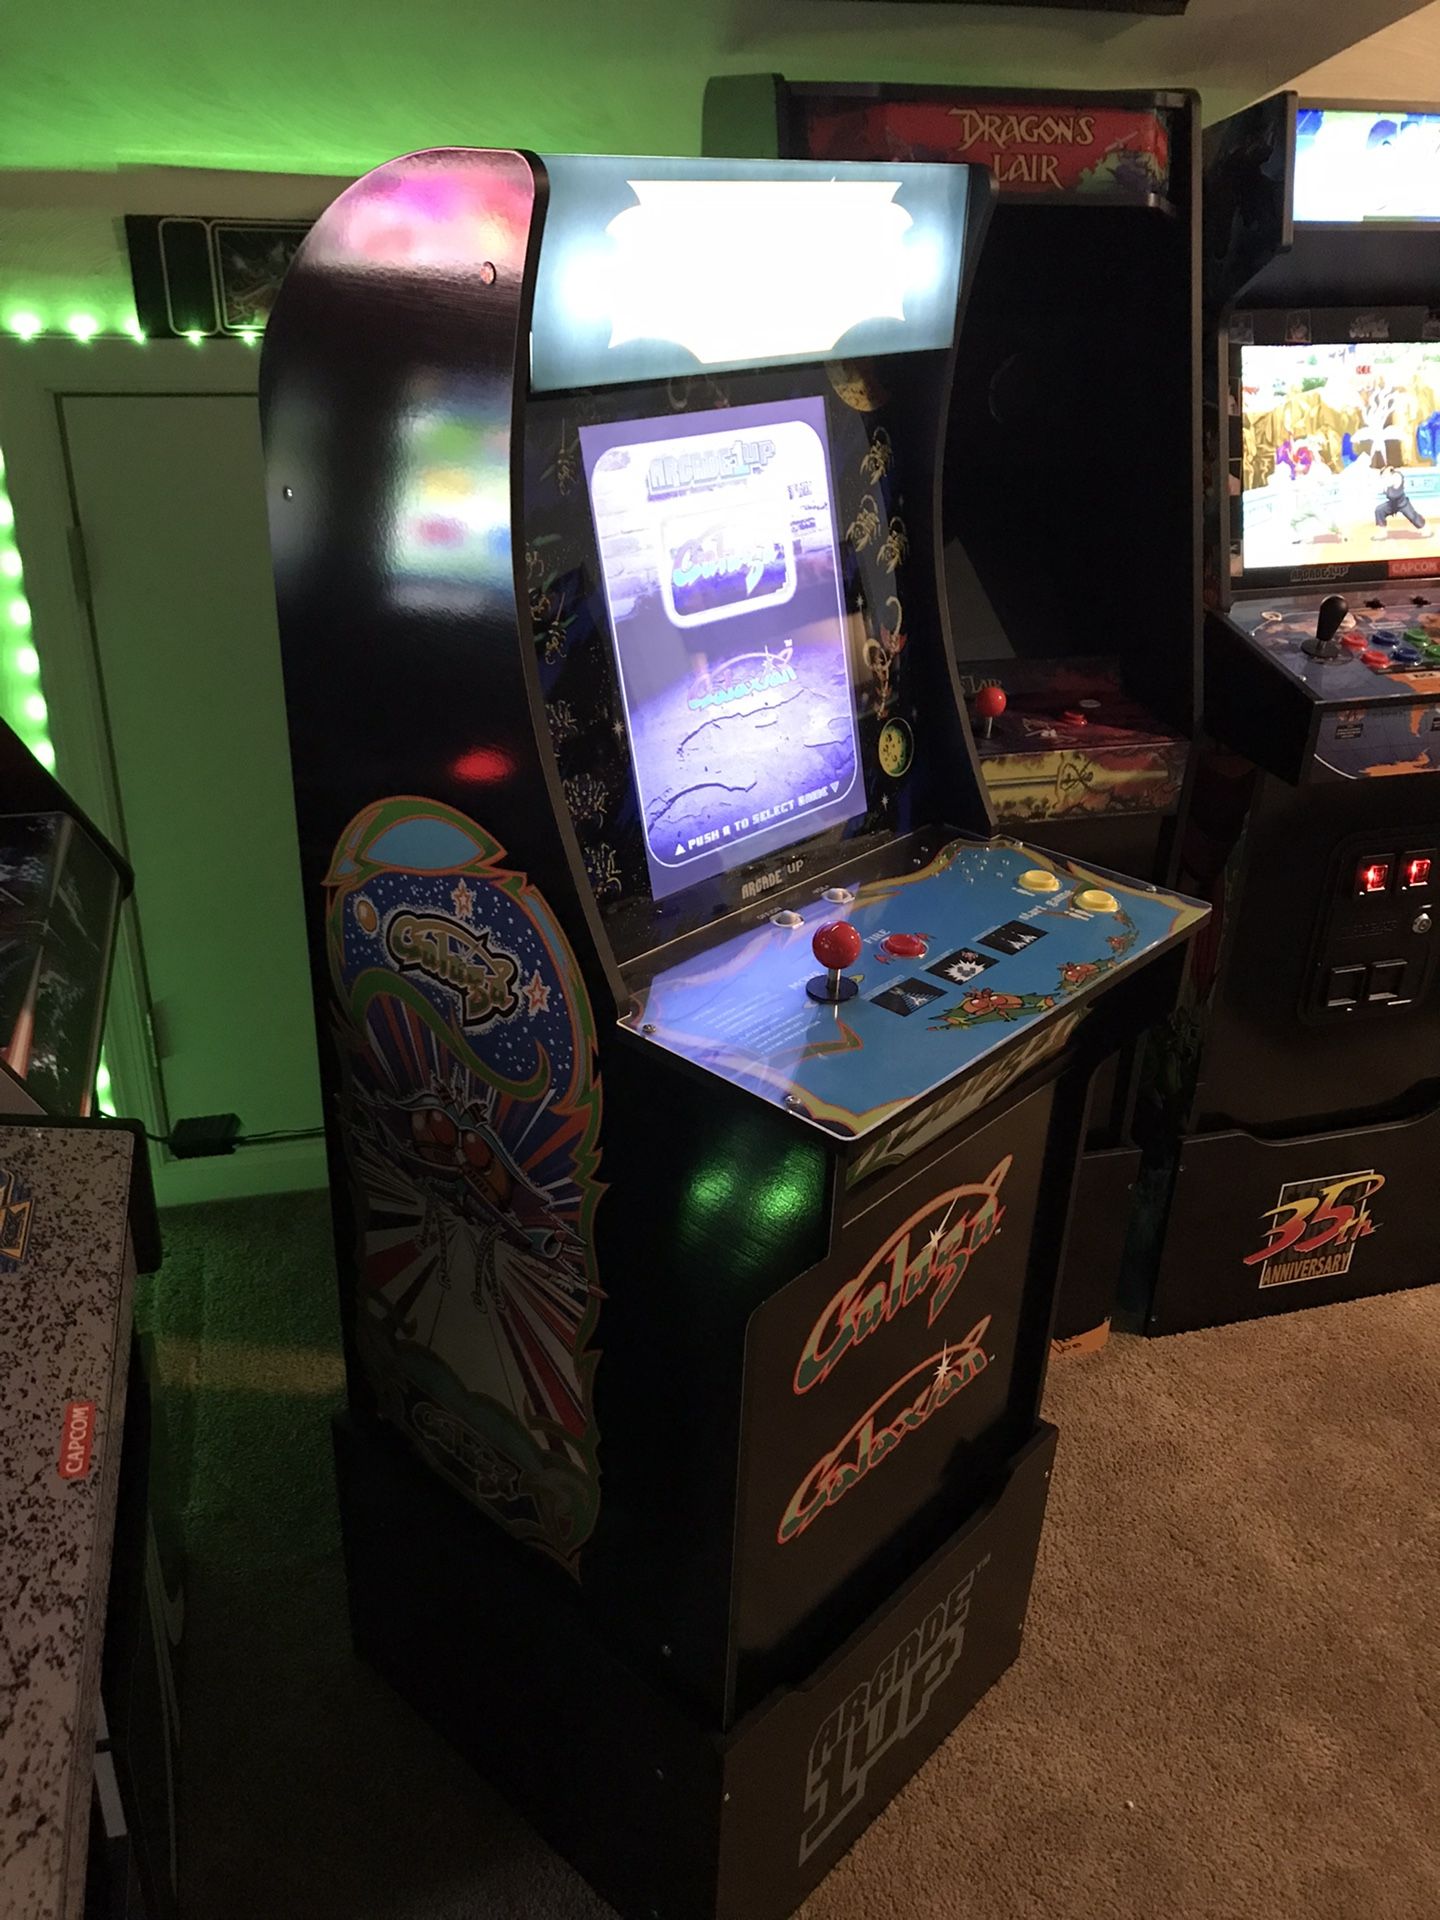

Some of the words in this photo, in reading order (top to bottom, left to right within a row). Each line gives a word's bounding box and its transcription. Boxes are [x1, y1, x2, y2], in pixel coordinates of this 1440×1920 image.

[948, 108, 1096, 152] DRAGONS
[993, 154, 1065, 190] LAIR
[1392, 560, 1437, 574] CAPCOM
[687, 829, 720, 850] PUSH
[734, 817, 750, 832] TO
[752, 799, 795, 825] SELECT
[741, 869, 783, 900] ARCADE
[862, 928, 891, 944] FIRE
[1261, 1252, 1350, 1286] ANNIVERSARY
[65, 1404, 90, 1475] CAPCOM
